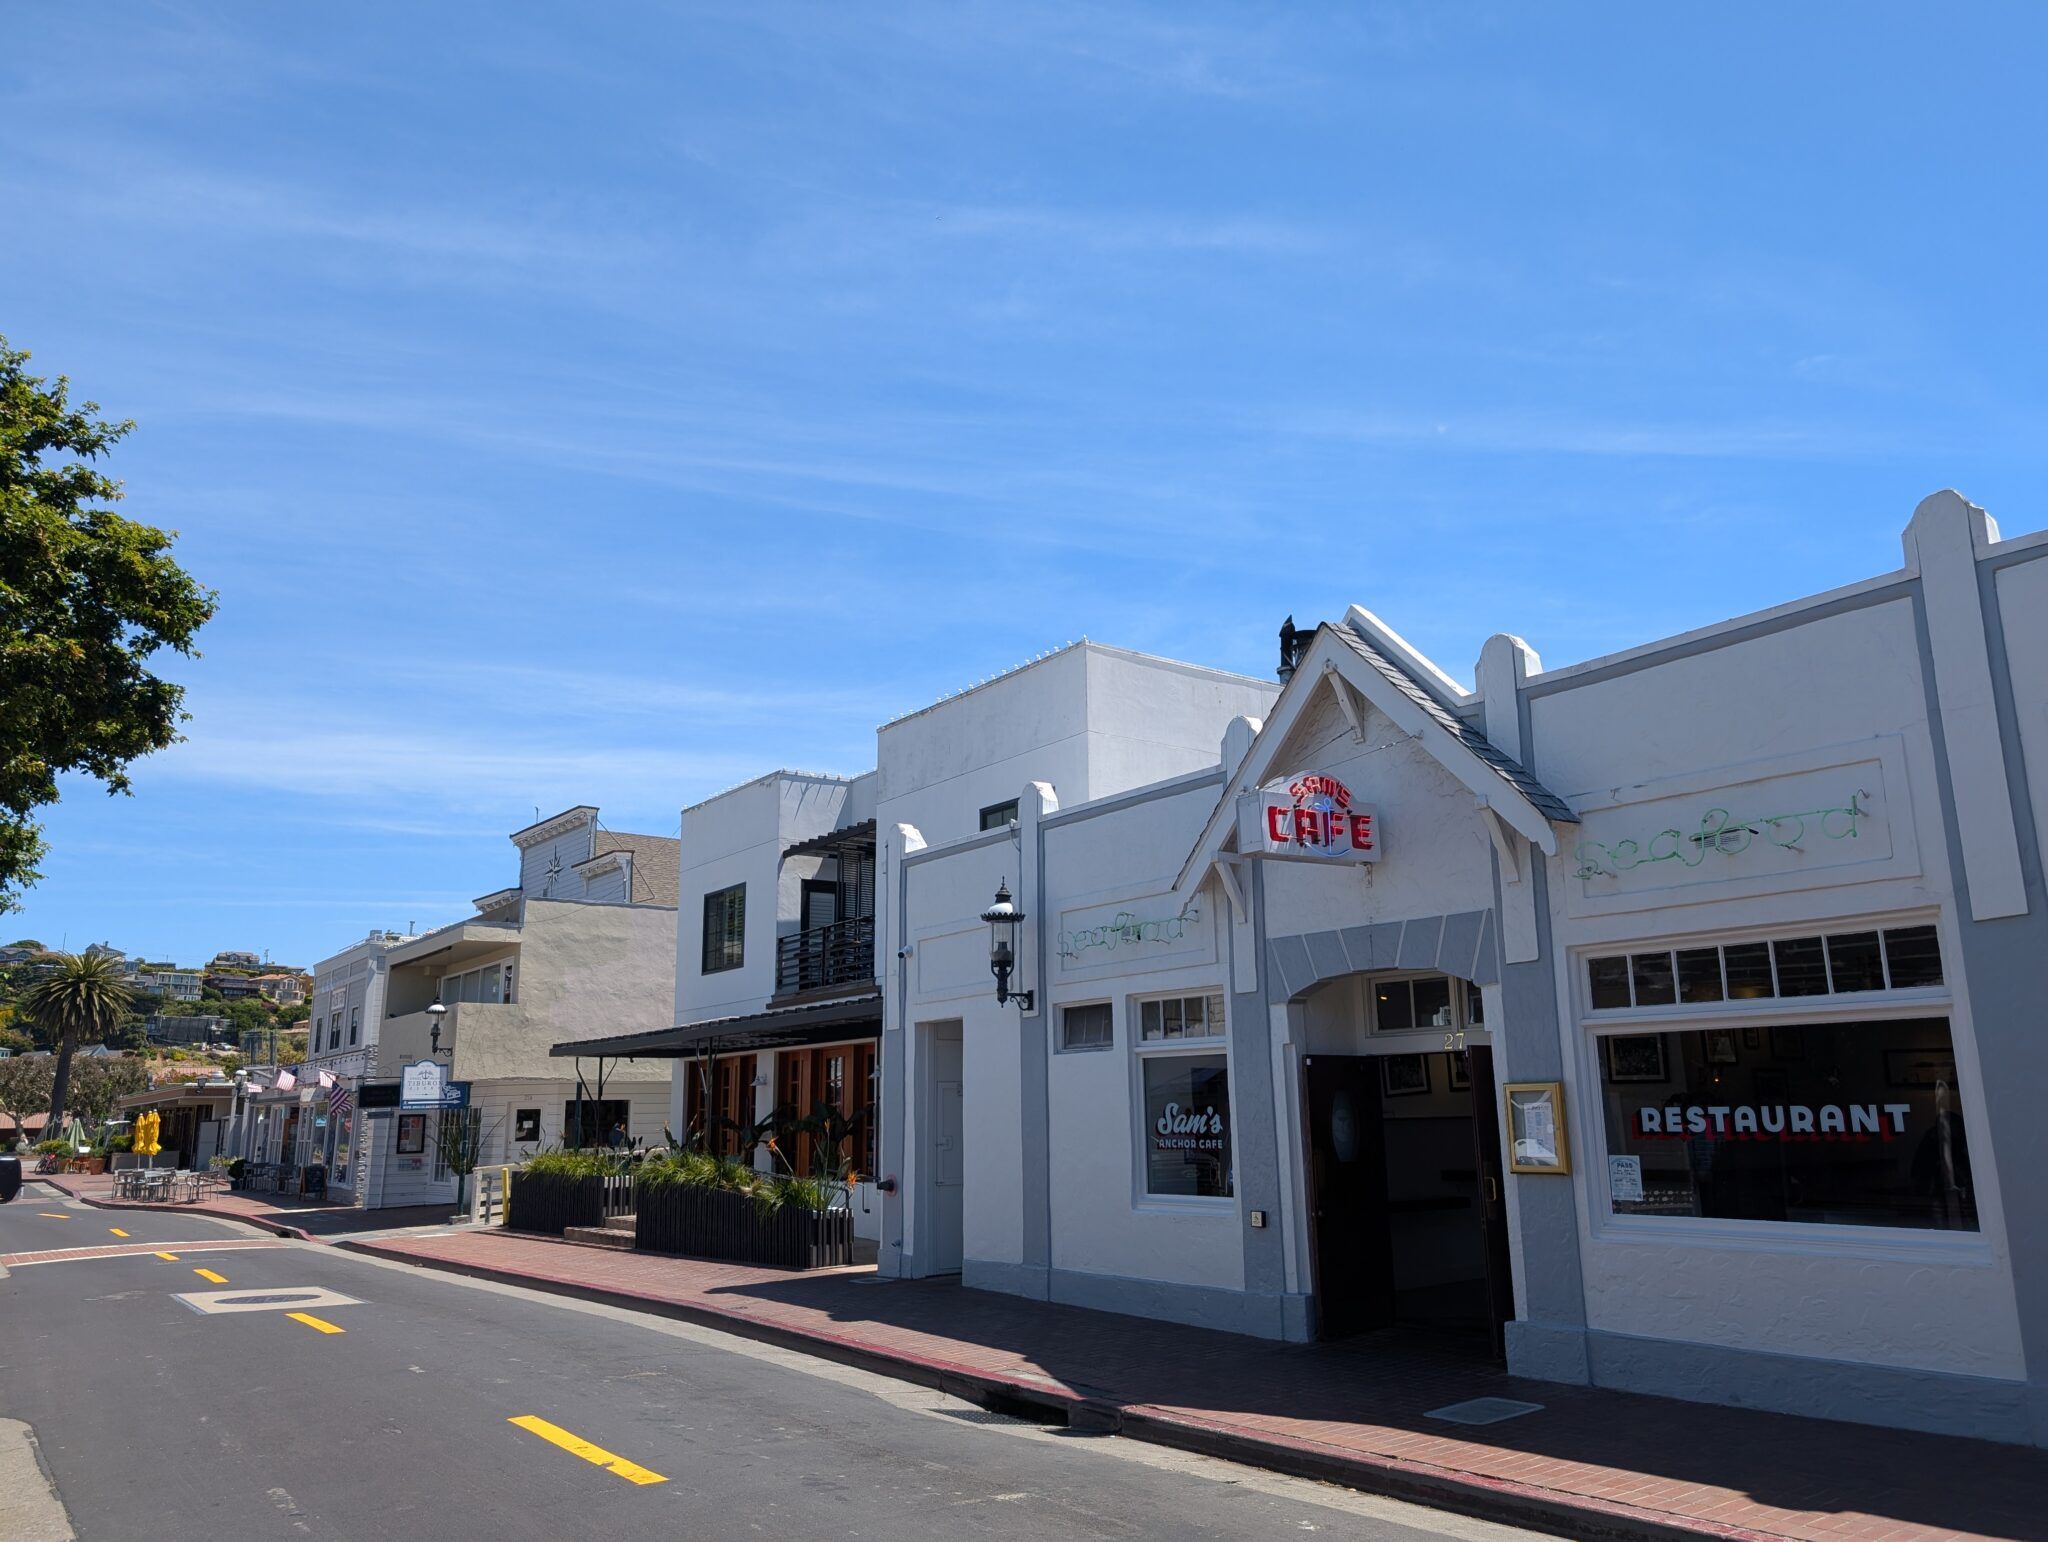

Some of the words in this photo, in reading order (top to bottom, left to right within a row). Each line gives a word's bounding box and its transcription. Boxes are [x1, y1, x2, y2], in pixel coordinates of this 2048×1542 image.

[1267, 805, 1375, 850] CAFE
[1573, 795, 1857, 880] seafood
[1444, 1032, 1464, 1050] 27
[1157, 1102, 1223, 1135] Sam's
[1638, 1103, 1911, 1135] RESTAURANT
[1158, 1138, 1197, 1149] ANCHOR
[1198, 1139, 1223, 1149] CAFE
